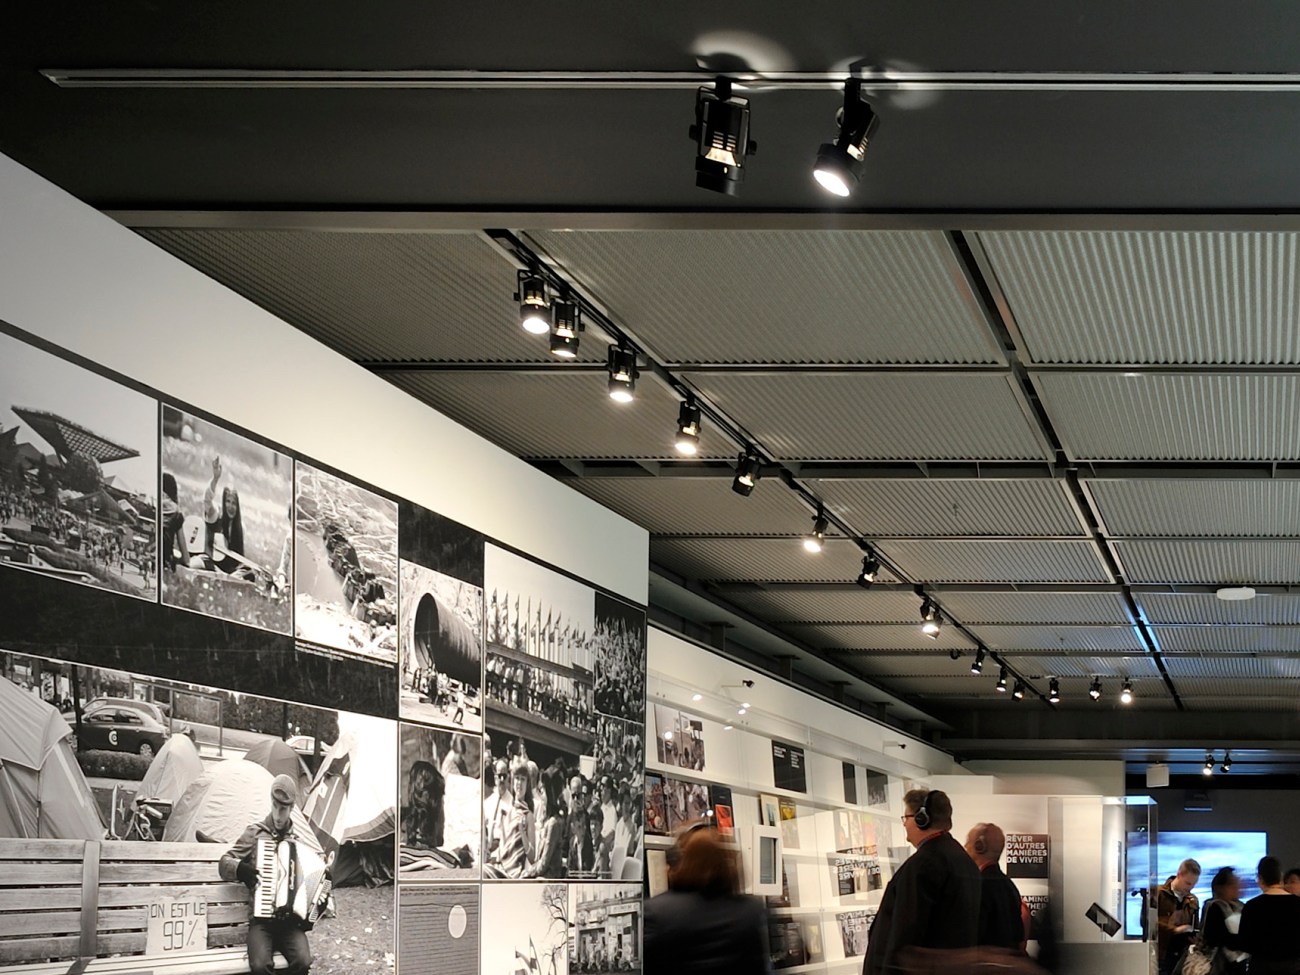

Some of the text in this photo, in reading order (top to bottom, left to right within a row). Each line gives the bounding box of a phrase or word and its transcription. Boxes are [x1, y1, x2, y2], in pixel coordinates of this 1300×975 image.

[1006, 834, 1033, 842] RÊVER
[1006, 842, 1045, 850] D'AUTRES
[1006, 848, 1047, 857] MANIÈRES
[1006, 856, 1044, 864] DE VIVRE
[151, 902, 206, 918] ON EST LE
[163, 919, 198, 951] 99%
